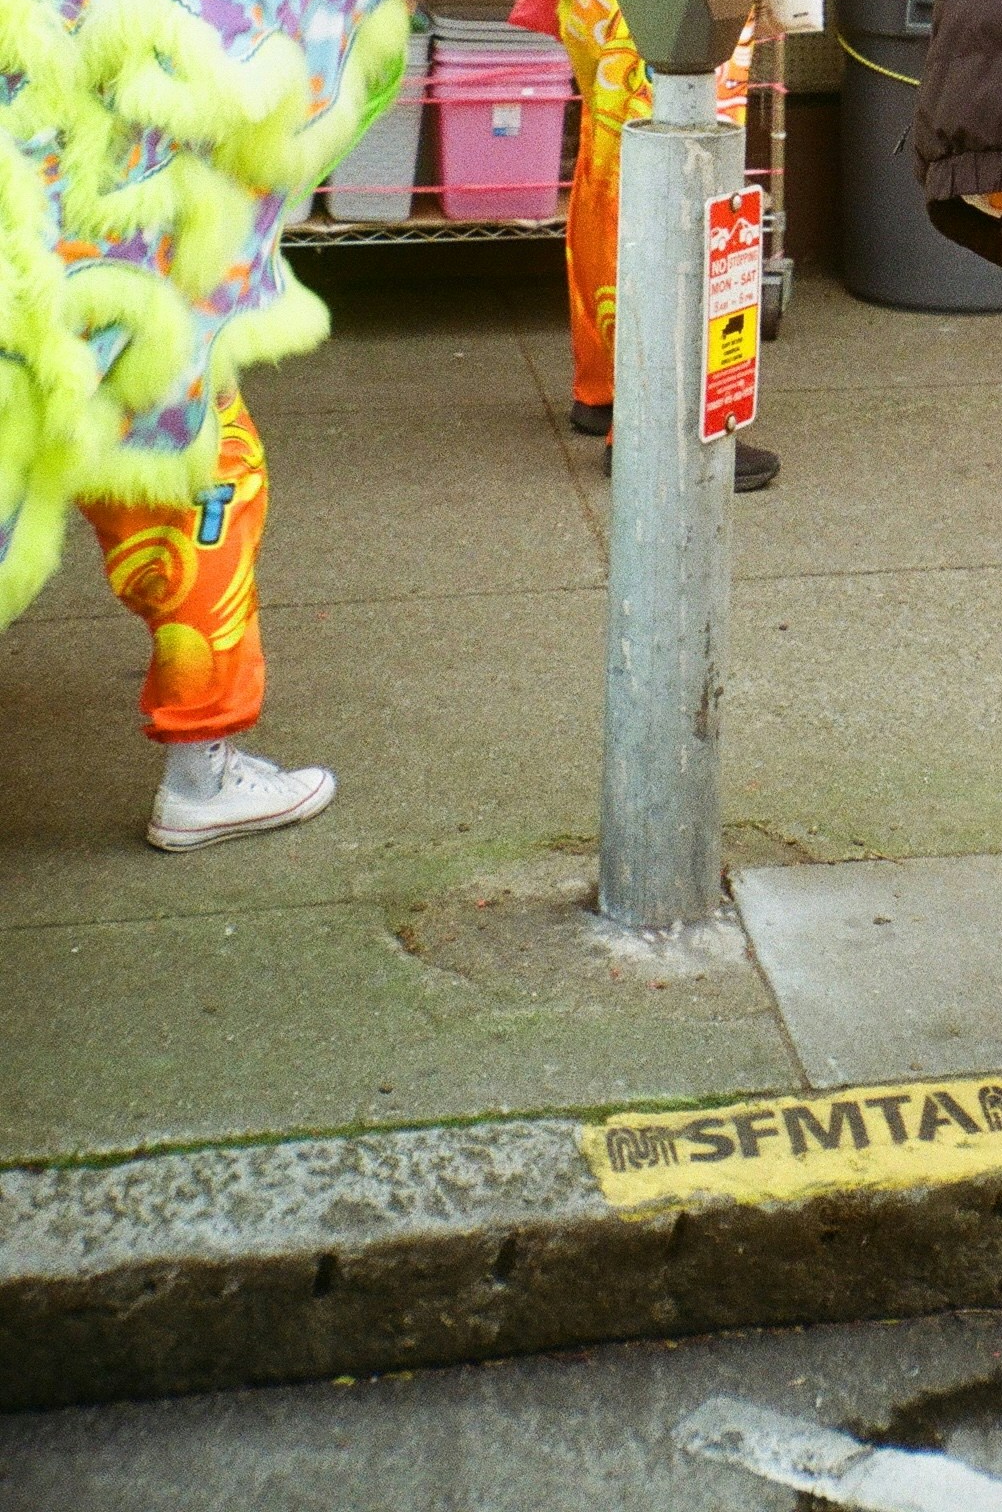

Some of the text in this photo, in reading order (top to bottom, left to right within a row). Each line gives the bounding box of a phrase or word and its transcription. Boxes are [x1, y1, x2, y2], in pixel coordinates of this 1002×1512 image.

[711, 258, 727, 276] NO
[711, 278, 732, 295] MON
[740, 269, 756, 286] SAT
[685, 1091, 982, 1164] SFMTA
